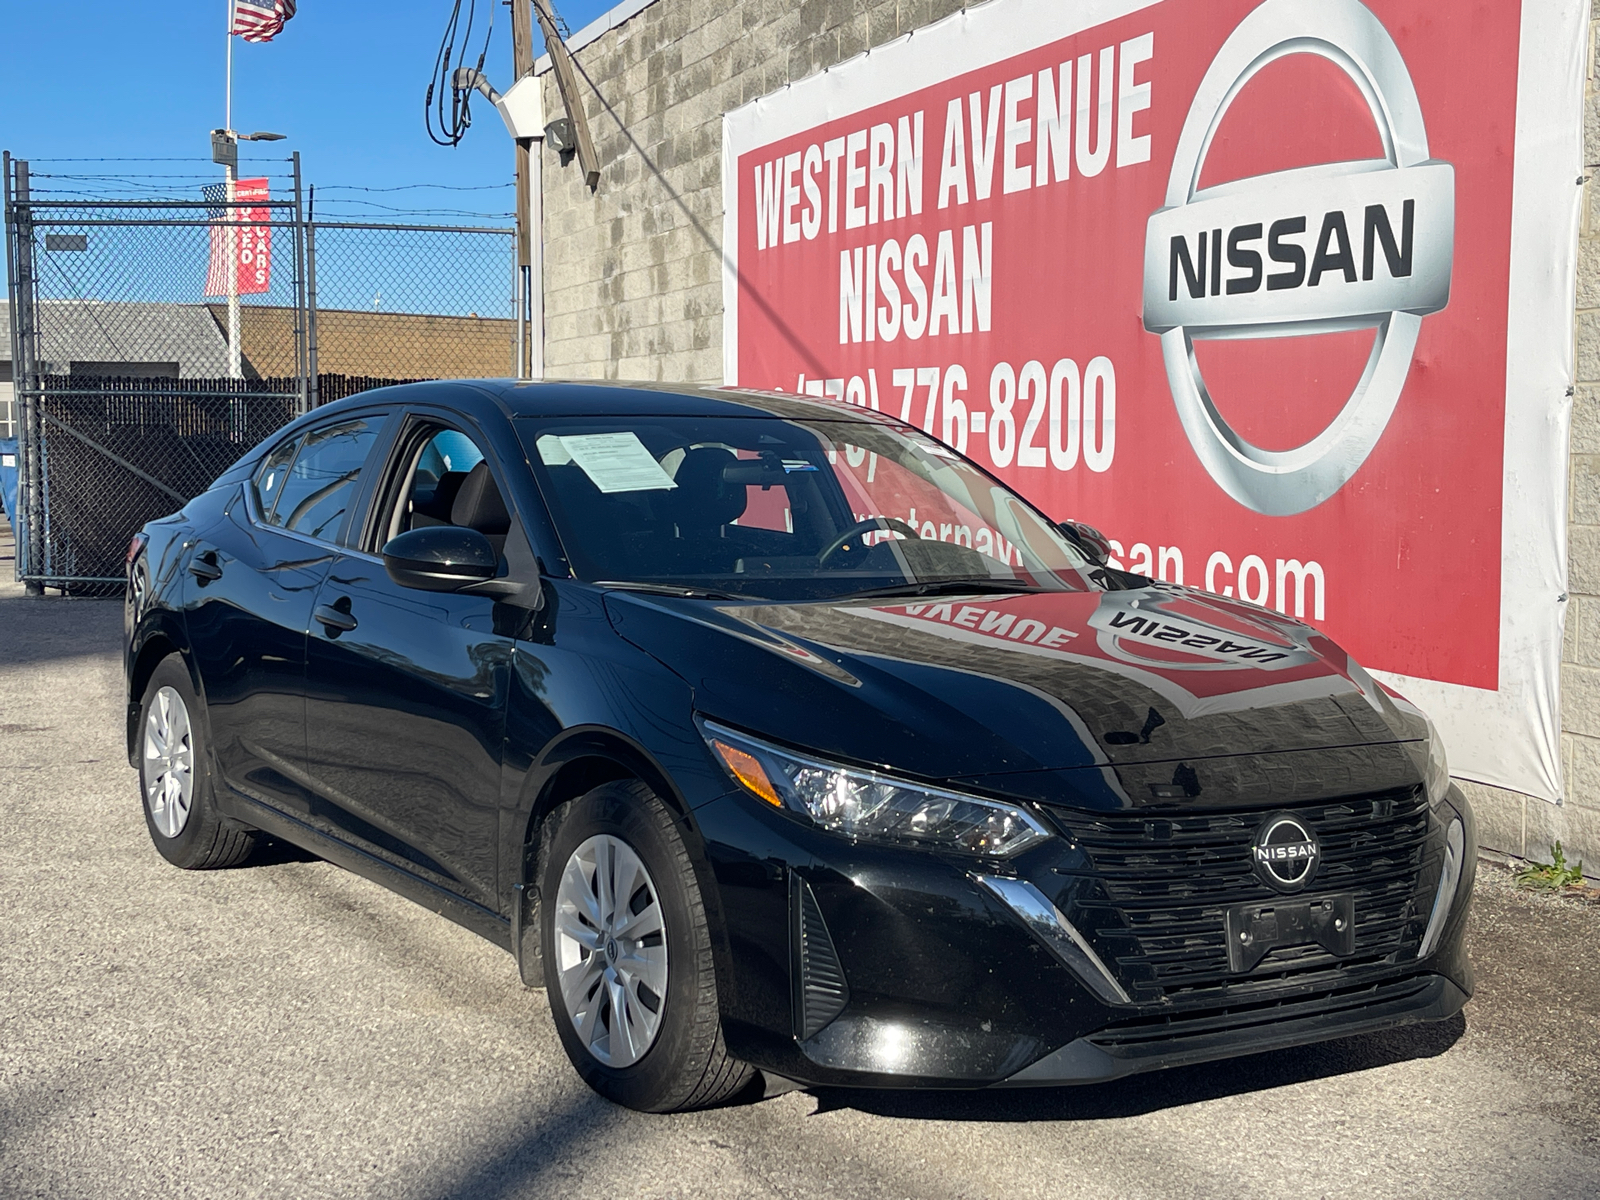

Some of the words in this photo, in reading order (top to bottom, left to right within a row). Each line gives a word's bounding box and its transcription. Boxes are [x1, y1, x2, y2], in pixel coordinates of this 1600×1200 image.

[754, 110, 924, 251] WESTERN
[937, 31, 1154, 210] AVENUE
[839, 221, 993, 345] NISSAN
[1168, 199, 1415, 302] NISSAN
[892, 356, 1116, 473] 776-8200
[1257, 843, 1317, 860] NISSAN
